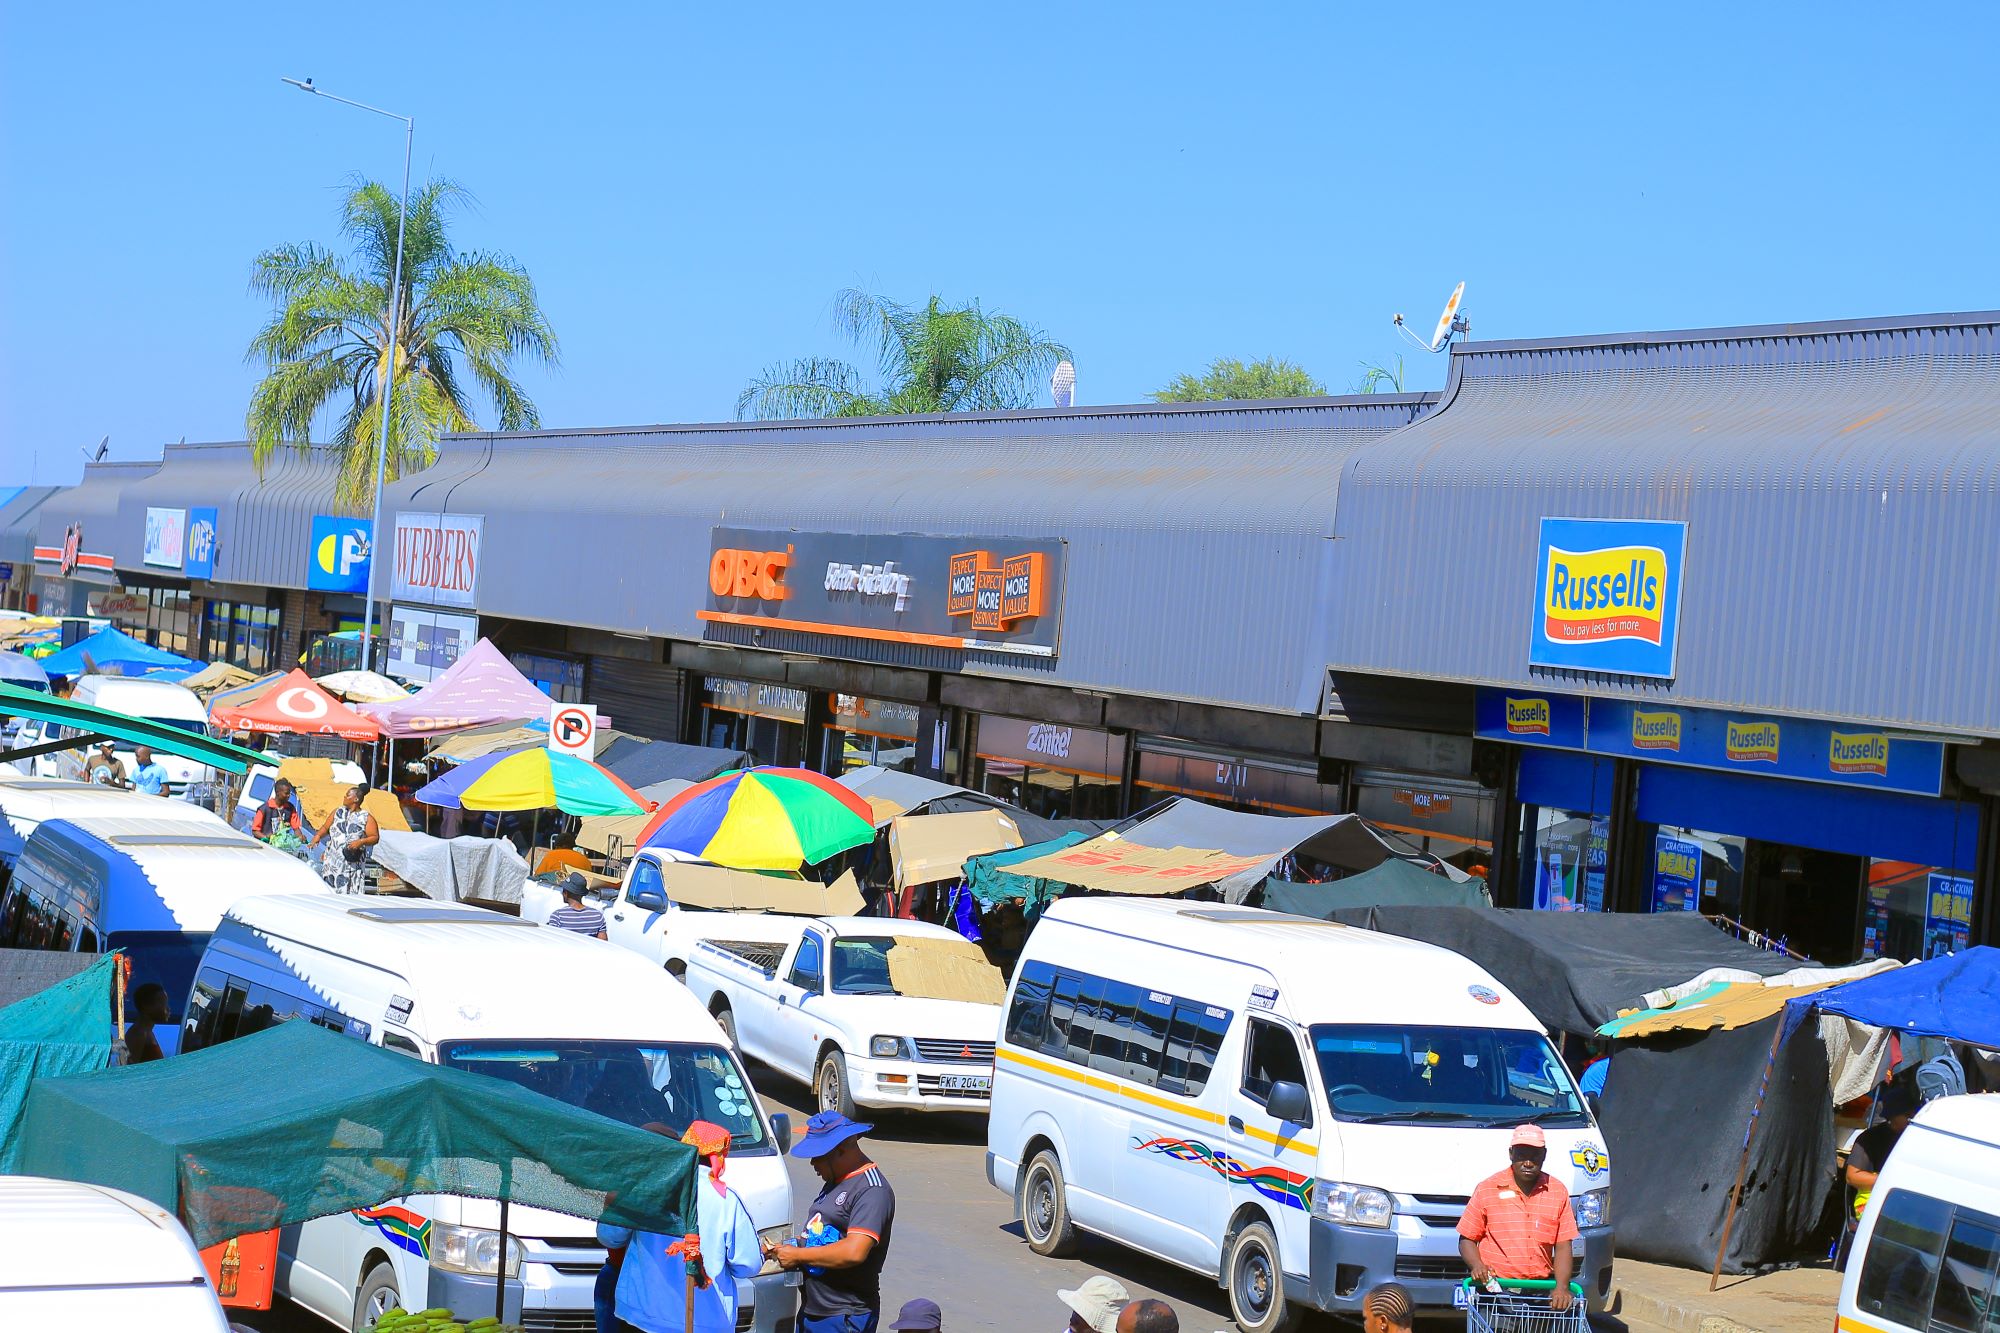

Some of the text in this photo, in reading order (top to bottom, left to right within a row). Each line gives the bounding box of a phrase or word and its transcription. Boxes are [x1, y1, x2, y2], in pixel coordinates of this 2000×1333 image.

[397, 527, 477, 592] WEBBERS
[953, 558, 976, 576] EXPECT
[709, 548, 789, 601] OBC
[1006, 560, 1030, 578] EXPECT
[952, 575, 975, 595] MORE
[978, 573, 1002, 589] EXPECT
[1005, 576, 1029, 597] MORE
[1551, 559, 1657, 611] Russells
[951, 595, 973, 610] QUALITY
[977, 591, 1000, 610] MORE
[1004, 596, 1028, 614] VALUE
[974, 612, 998, 626] SERVICE
[1563, 623, 1575, 636] You
[1577, 626, 1589, 639] pay
[1591, 622, 1605, 634] less
[1606, 619, 1617, 632] for
[704, 676, 749, 697] PARCEL COUNTER
[1509, 704, 1547, 722] Russells
[254, 722, 293, 733] vodacom
[335, 729, 373, 738] vodacom
[1635, 717, 1678, 737] Russells
[1729, 727, 1776, 748] Russells
[1833, 738, 1884, 760] Russells
[1414, 794, 1431, 807] MORE
[1665, 841, 1694, 854] CRACKING
[1657, 850, 1697, 881] DEALS
[940, 1076, 958, 1088] FKR
[961, 1077, 977, 1089] 204
